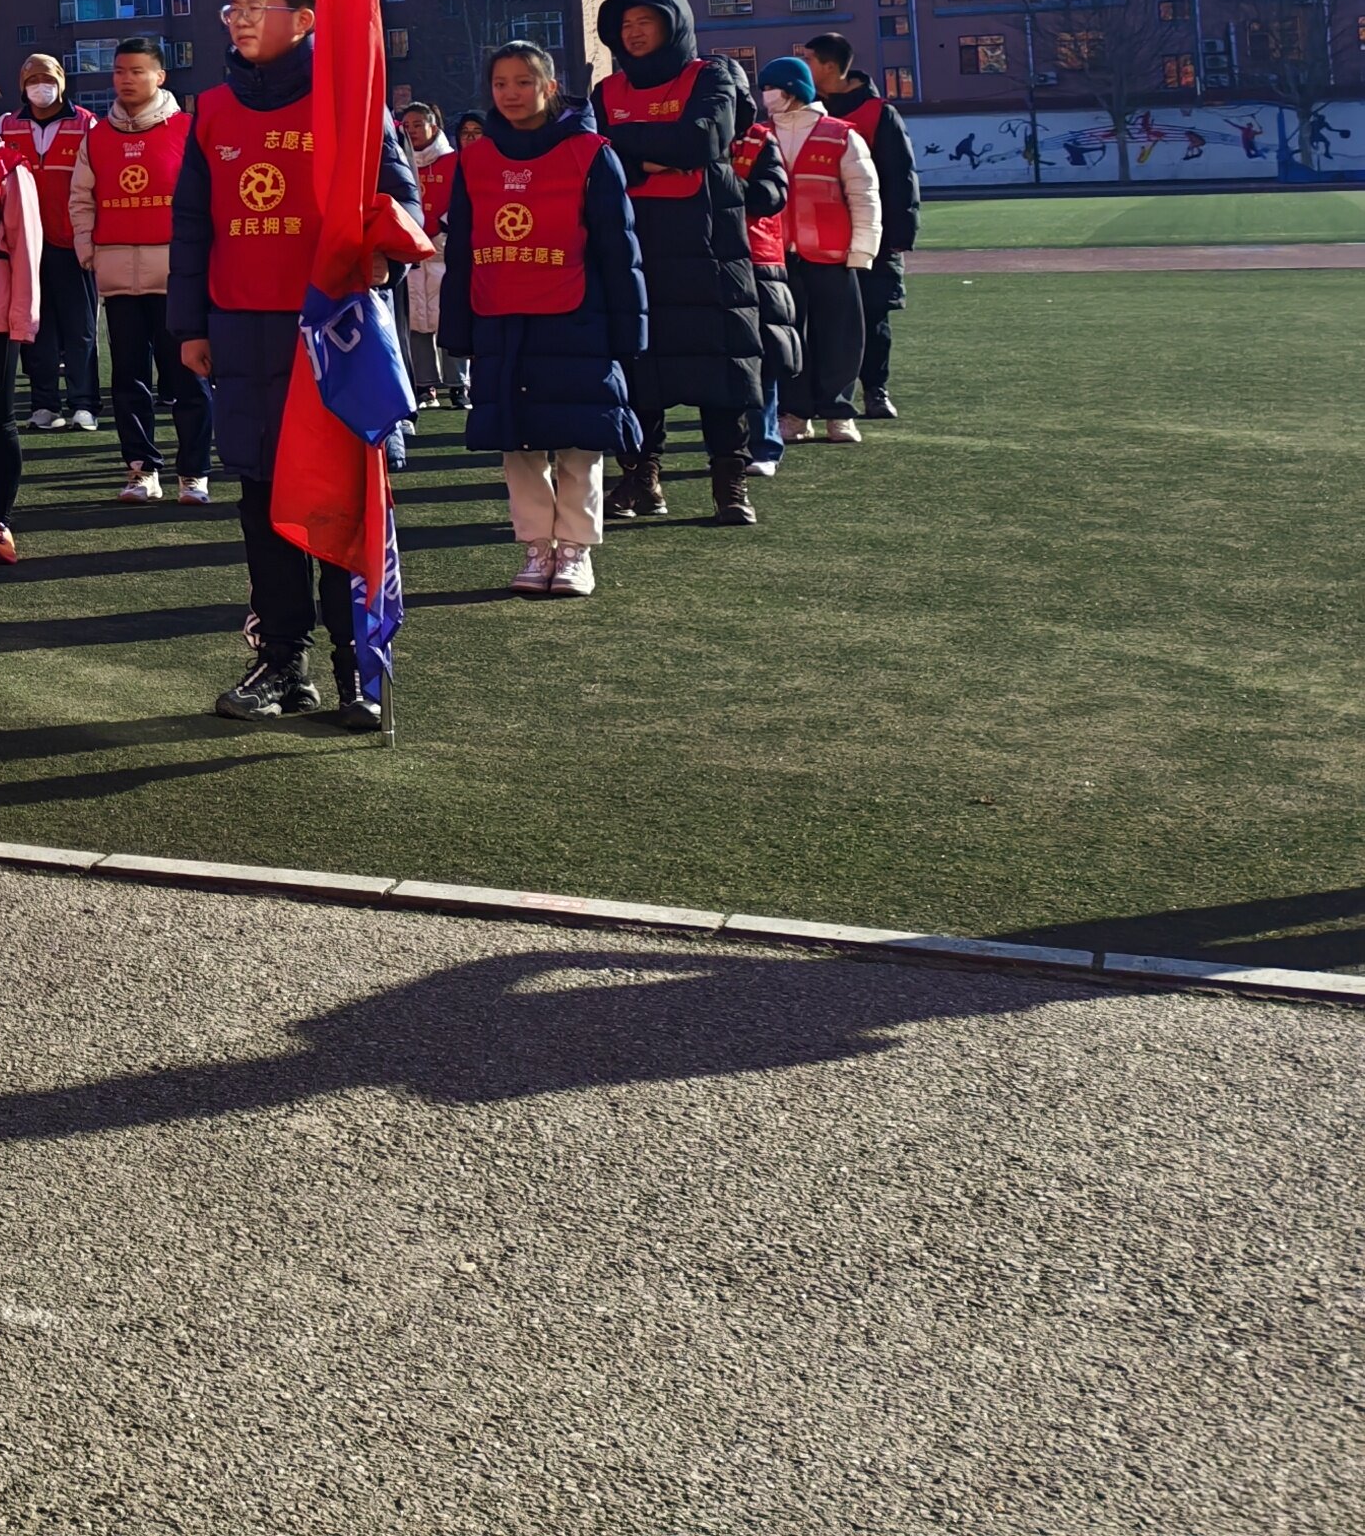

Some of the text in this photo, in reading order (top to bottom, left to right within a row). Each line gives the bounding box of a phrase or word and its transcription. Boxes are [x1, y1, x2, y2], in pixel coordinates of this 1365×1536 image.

[229, 217, 302, 236] 爱民拥警
[473, 246, 565, 265] 爱民拥警志愿者
